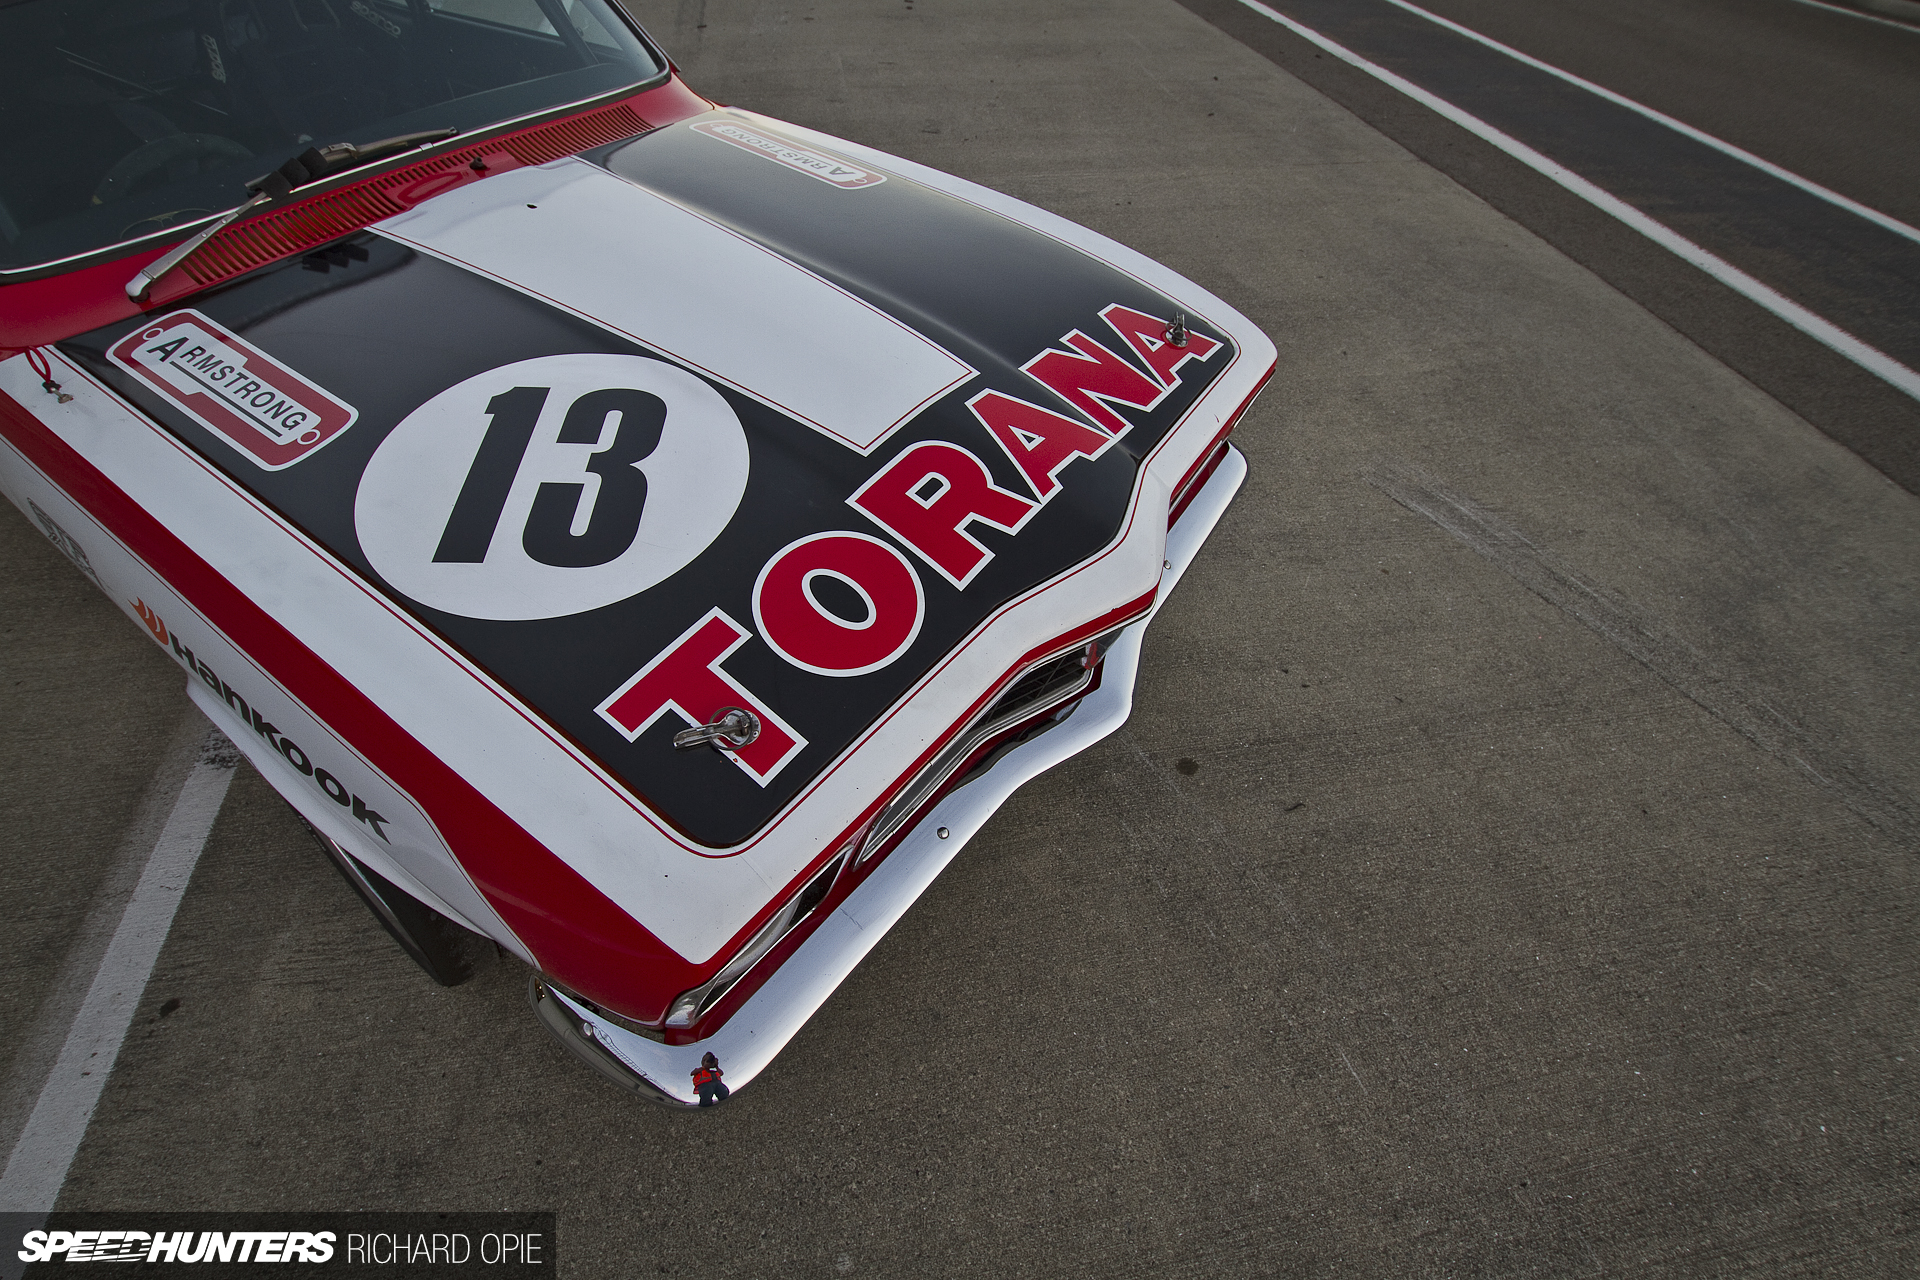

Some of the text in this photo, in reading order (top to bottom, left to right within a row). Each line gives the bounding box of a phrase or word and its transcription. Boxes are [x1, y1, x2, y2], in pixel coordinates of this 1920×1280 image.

[721, 127, 856, 176] ARMSTRONG
[146, 336, 308, 431] ARMSTRONG
[431, 386, 668, 568] 13
[594, 303, 1223, 787] TORANA
[168, 630, 392, 846] Hankook
